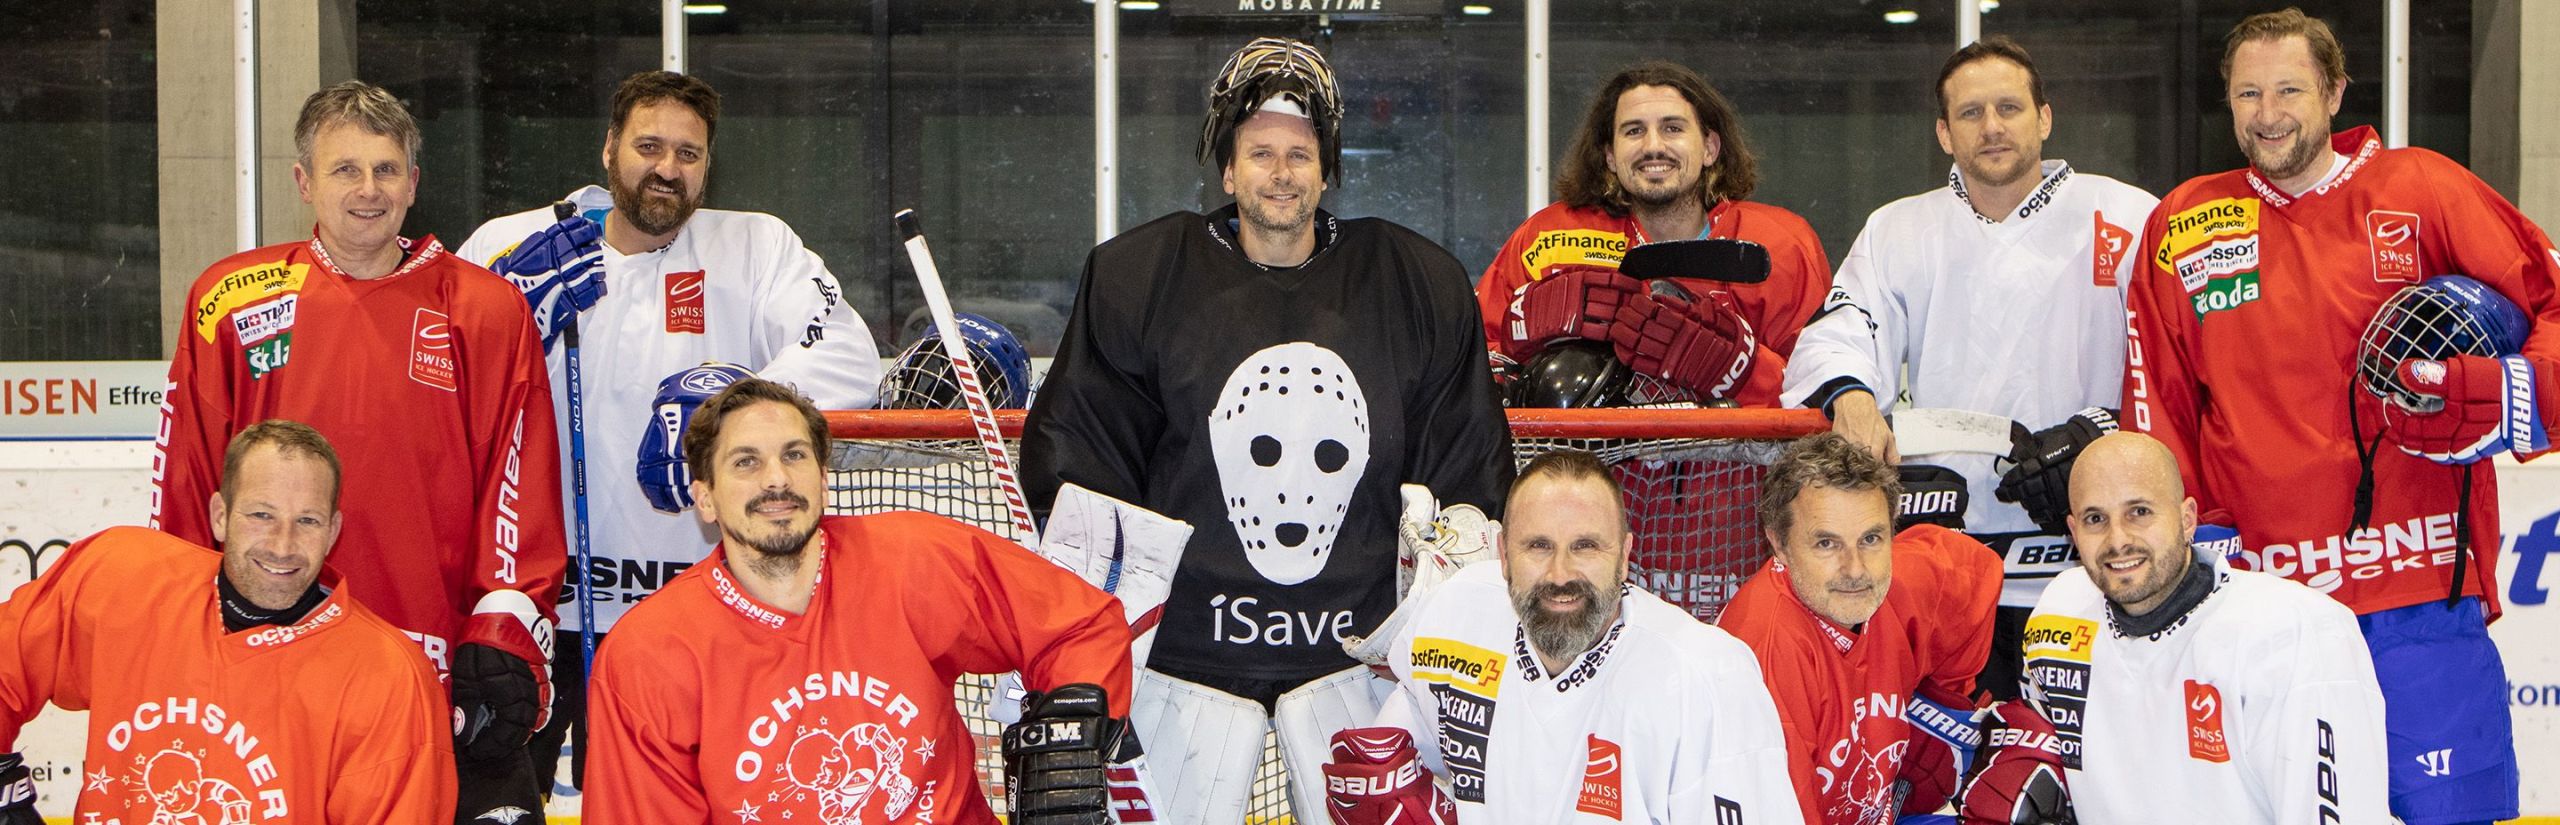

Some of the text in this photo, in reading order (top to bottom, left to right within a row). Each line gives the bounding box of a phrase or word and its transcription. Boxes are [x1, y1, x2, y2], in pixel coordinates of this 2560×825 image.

[1238, 0, 1382, 11] MOBATIME
[1525, 233, 1626, 267] PtFinance
[2158, 204, 2245, 265] PFinance
[1584, 252, 1624, 262] SWISS POS
[671, 307, 704, 318] SWISS
[415, 351, 454, 371] SWISS
[415, 364, 426, 372] ICE
[4, 378, 163, 416] ISEN Effre
[570, 356, 582, 433] EASTON
[952, 357, 1034, 534] WARRIOR
[711, 566, 787, 627] OCHSNER
[1209, 594, 1353, 646] iSave
[735, 670, 920, 783] OCHSNER
[1989, 728, 2062, 756] BAUE
[107, 696, 288, 820] OCHSNER
[1328, 751, 1424, 796] BAUER
[1590, 797, 1617, 809] HOCKEY
